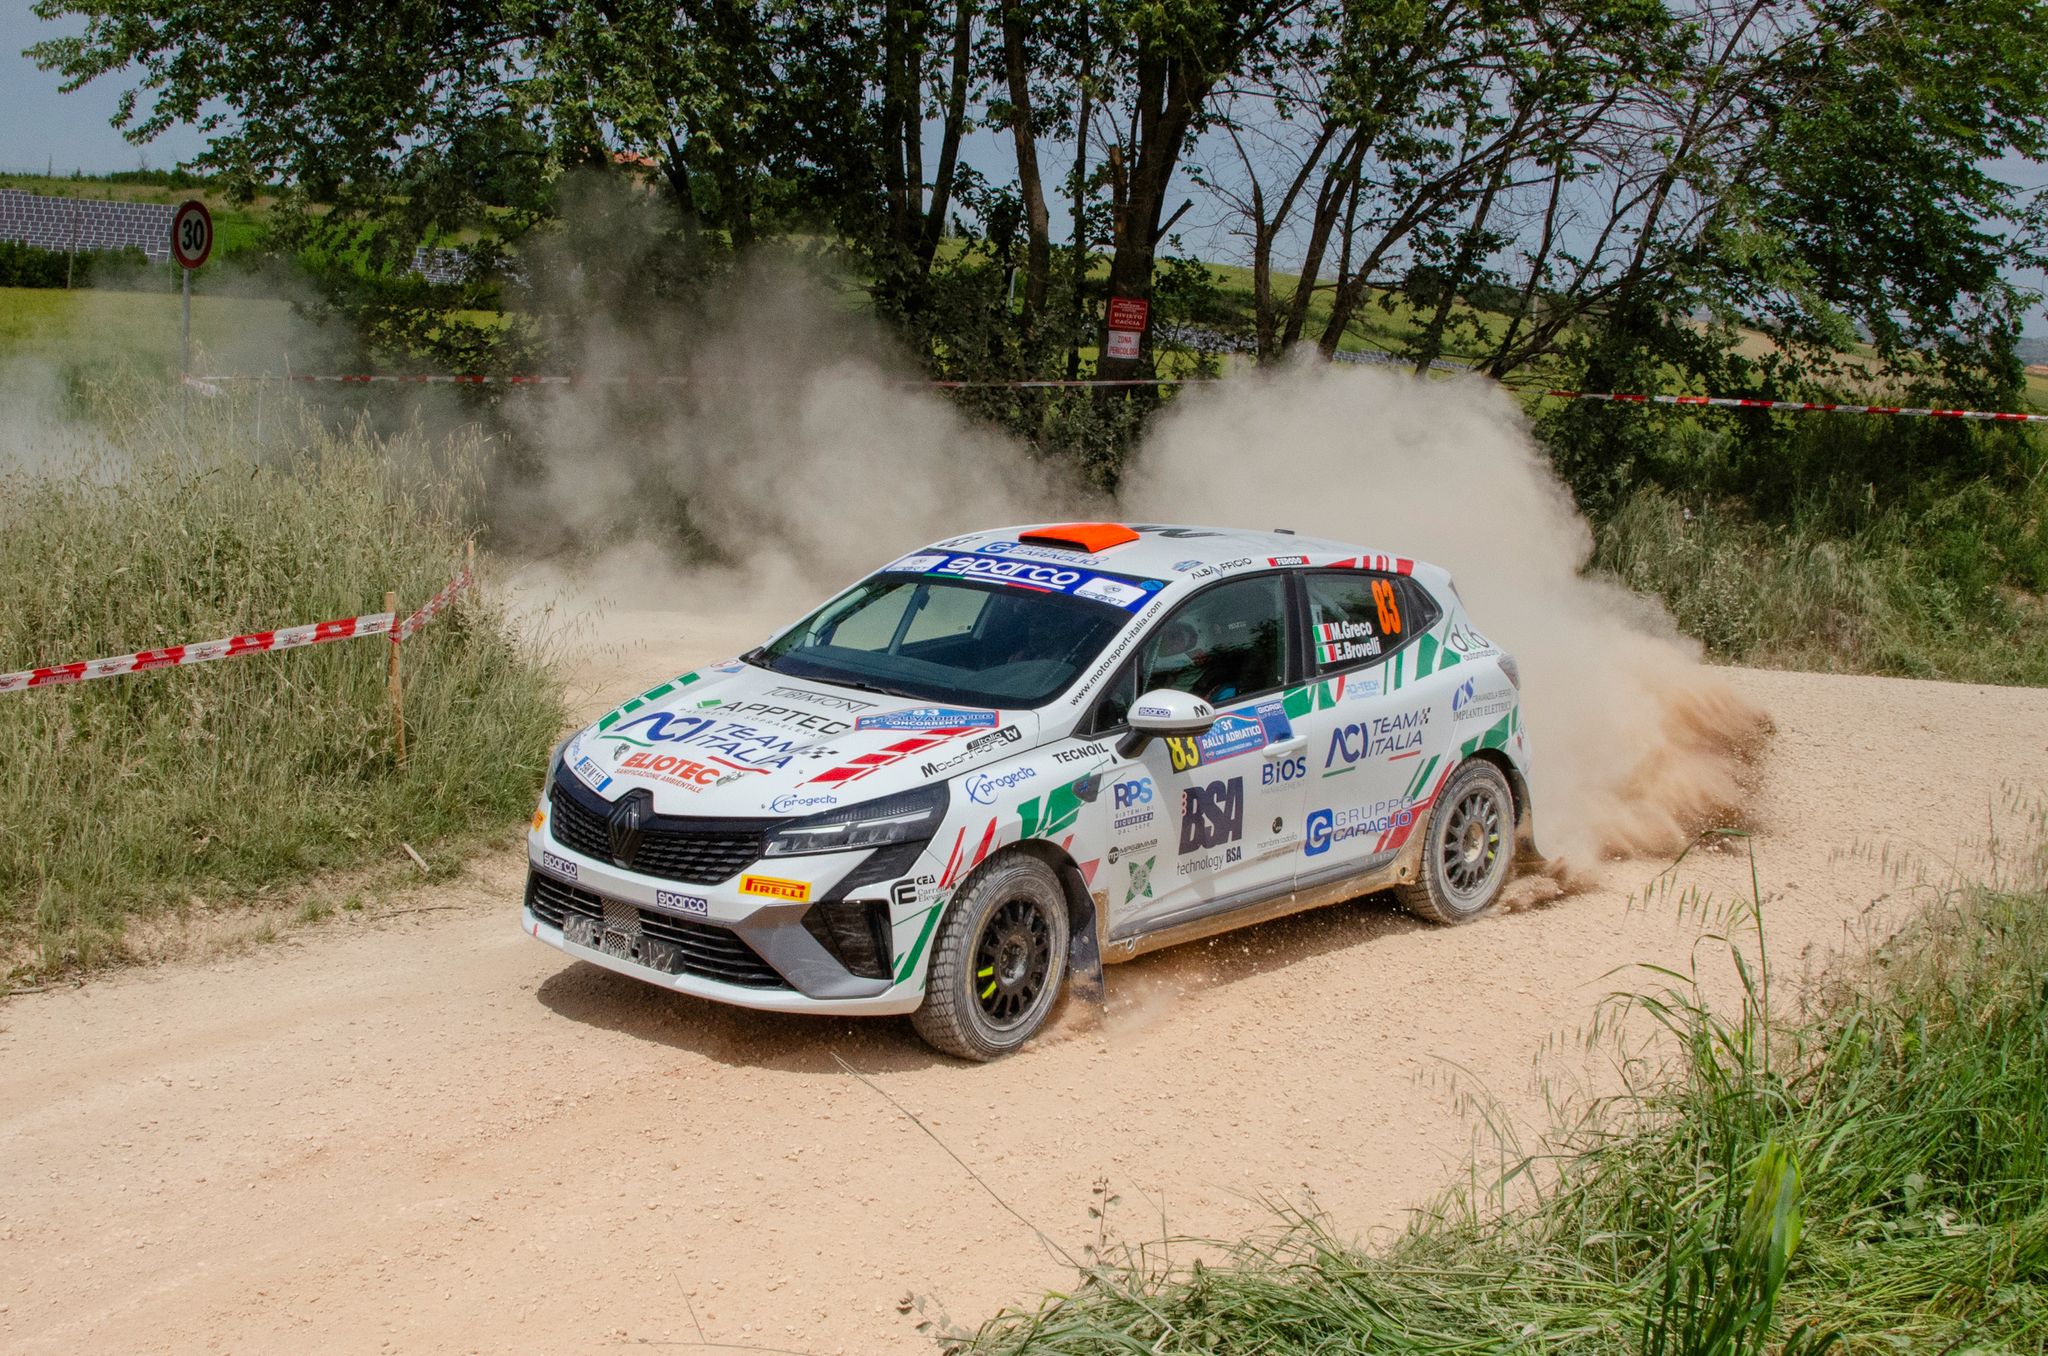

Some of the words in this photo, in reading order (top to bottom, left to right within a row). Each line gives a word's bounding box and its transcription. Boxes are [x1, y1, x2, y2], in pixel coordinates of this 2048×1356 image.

[182, 218, 205, 251] 30
[1114, 311, 1143, 320] DIVIETO
[946, 556, 1081, 586] sparco
[1371, 579, 1402, 635] 83
[1330, 621, 1373, 640] M.Greco
[1070, 600, 1163, 706] www.motorsport-italia.com
[1334, 637, 1381, 660] E.Brovelli
[613, 712, 717, 742] ACI
[714, 723, 813, 753] TEAM
[714, 701, 852, 735] APPTEC
[1004, 728, 1018, 741] tv
[1202, 735, 1224, 749] RALLY
[1225, 725, 1261, 743] ADRIATICO
[1325, 723, 1368, 768] ACI
[1373, 711, 1419, 736] TEAM
[1368, 730, 1422, 757] ITALIA
[683, 734, 793, 768] ITALIA
[1052, 742, 1109, 764] TECNOIL
[1167, 736, 1199, 770] 83
[615, 768, 661, 780] SANIFICAZIONE
[660, 776, 704, 794] AMBIENTALE
[622, 752, 720, 785] ELIOTEC
[980, 766, 1037, 797] progecta
[784, 795, 838, 808] progecta
[1114, 777, 1153, 810] RPS
[1178, 776, 1243, 855] BSA
[1335, 795, 1413, 827] GRUPPO
[1333, 811, 1412, 842] CARAGLIO
[544, 853, 577, 874] sparco
[1177, 854, 1224, 875] technology
[1226, 846, 1241, 863] BSA
[745, 878, 806, 899] PIRELLI
[916, 874, 936, 885] CEA
[658, 891, 707, 912] sparco
